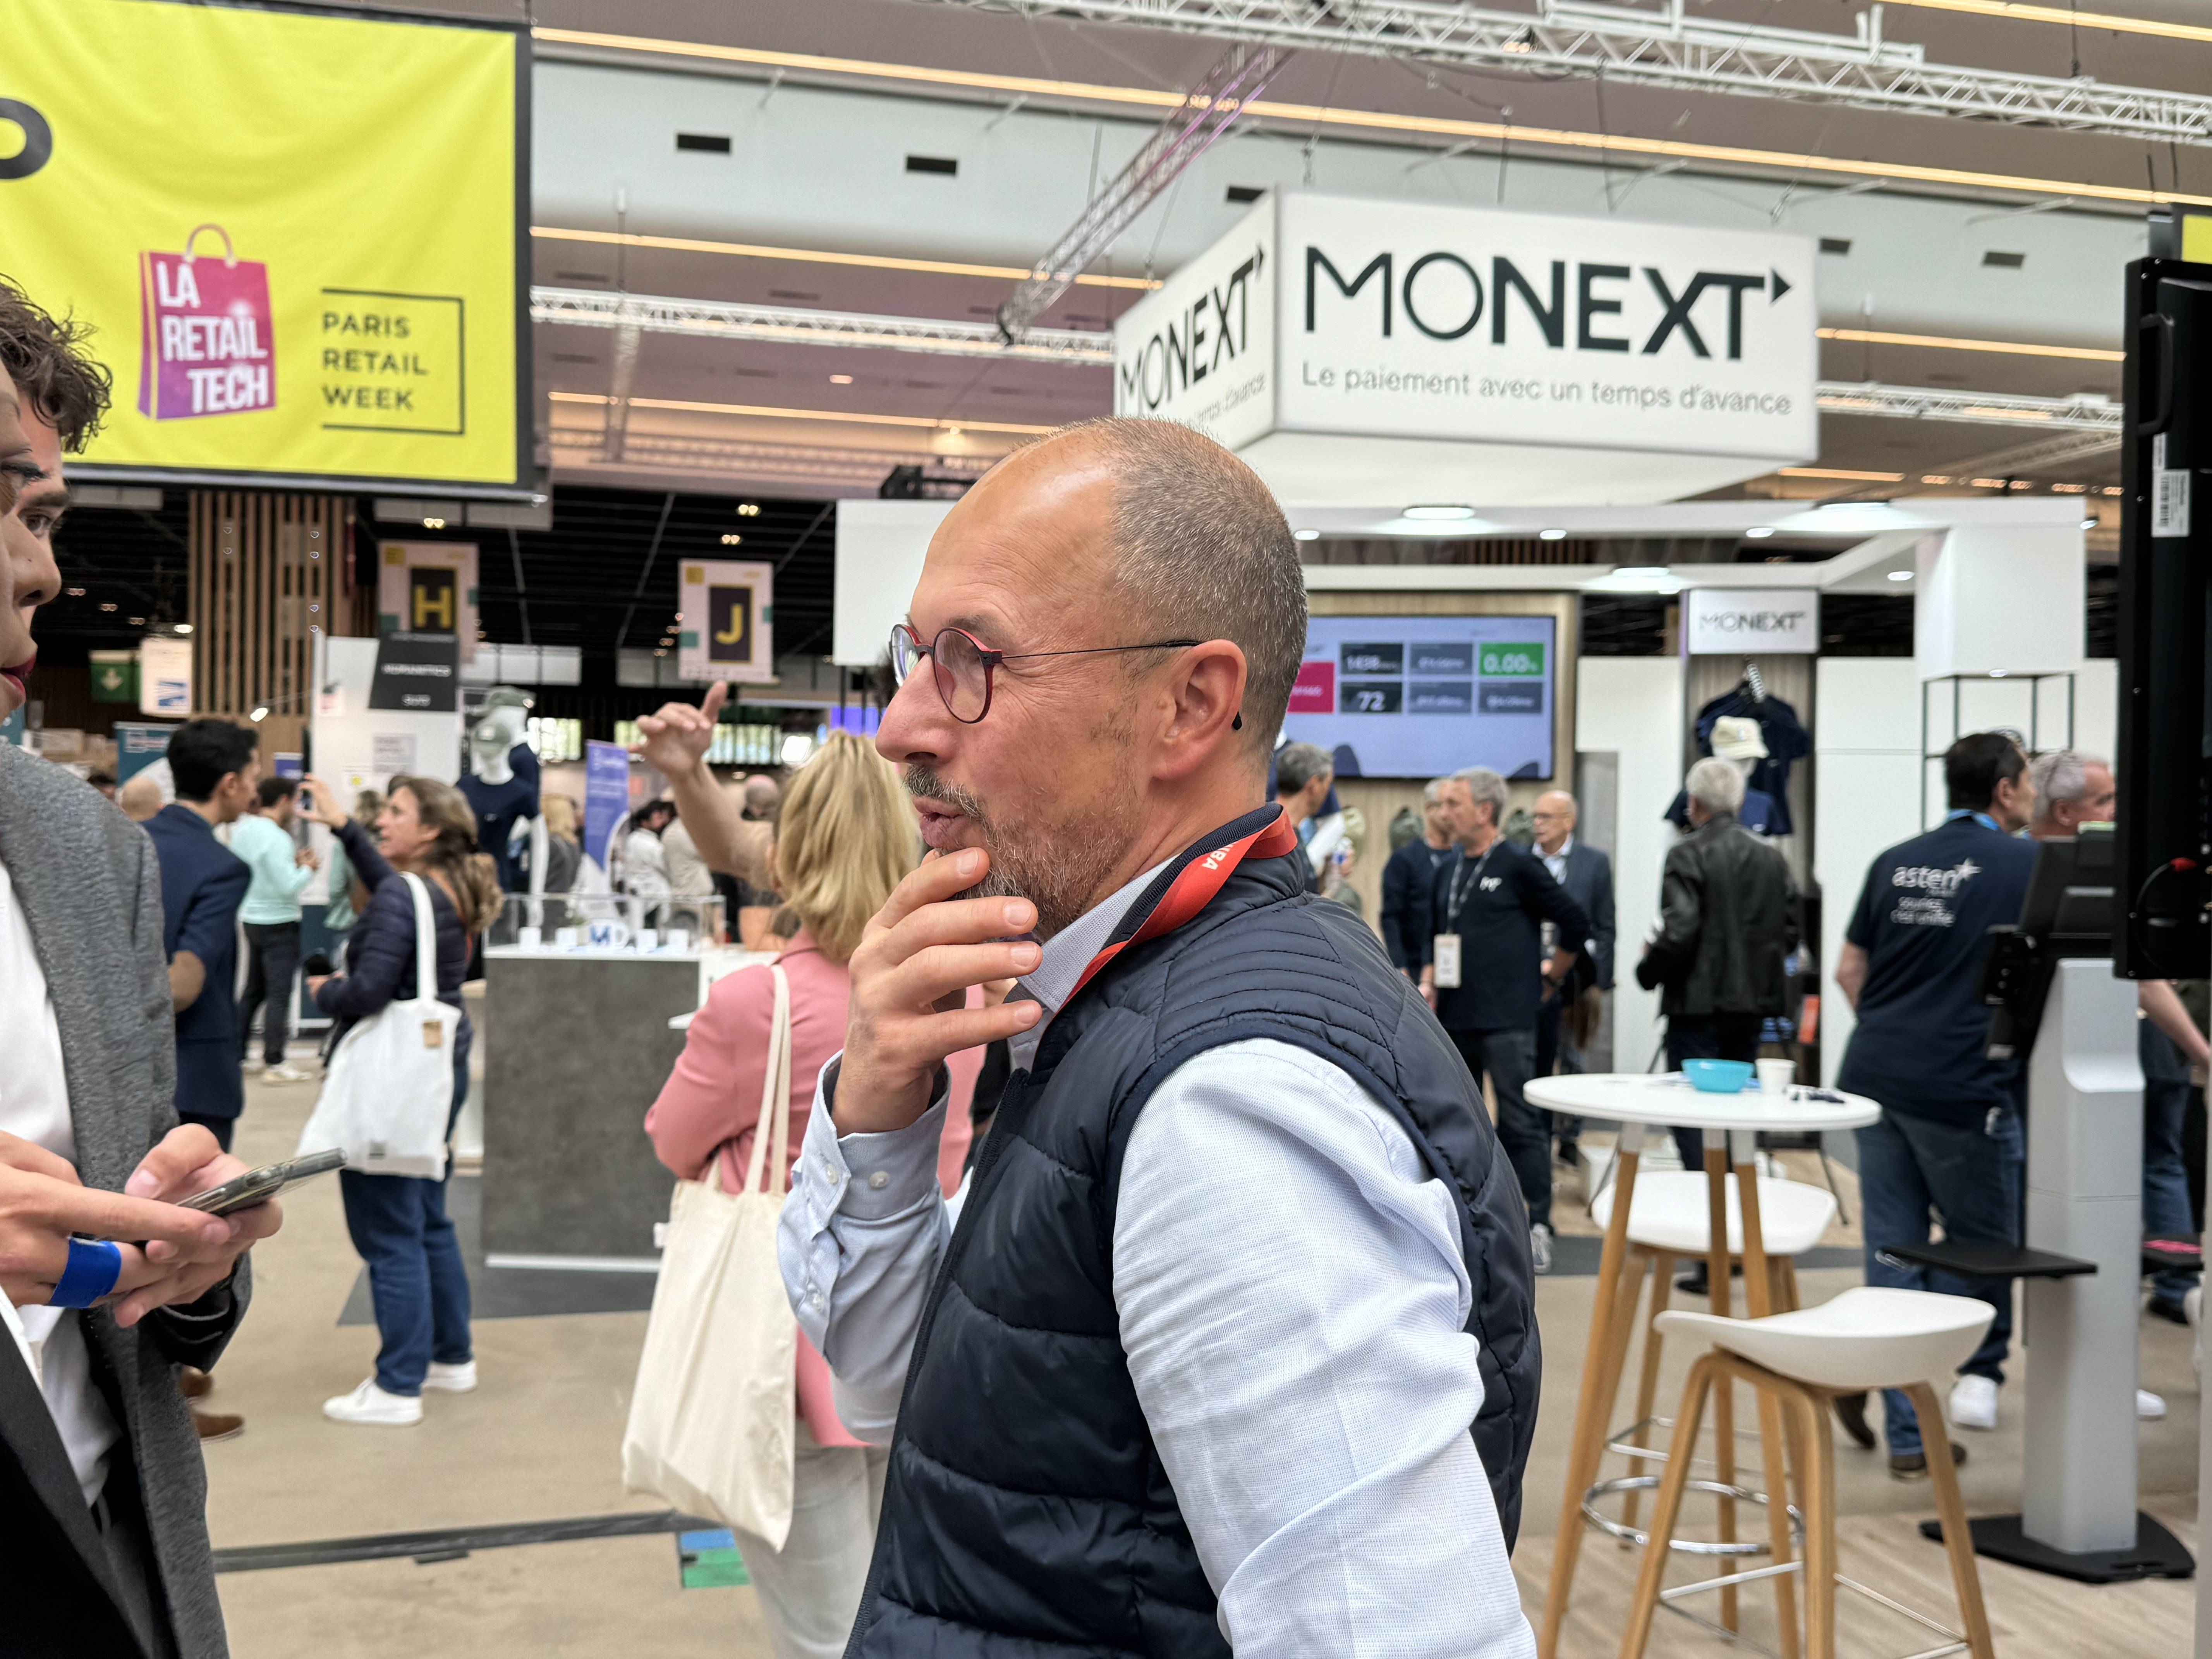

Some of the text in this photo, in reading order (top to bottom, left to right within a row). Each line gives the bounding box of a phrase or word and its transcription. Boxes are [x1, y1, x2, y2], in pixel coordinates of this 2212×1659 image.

[156, 261, 201, 308] LA
[1306, 246, 1765, 360] MONEXT
[161, 314, 268, 361] RETAIL
[322, 312, 410, 338] PARIS
[1120, 252, 1254, 417] MONEXT
[322, 348, 428, 376] RETAIL
[187, 365, 269, 414] TECH
[322, 386, 414, 412] WEEK
[1302, 361, 1793, 416] Le paiement avec un temps d'avance
[414, 585, 452, 629] H
[715, 604, 742, 645] J
[1699, 611, 1805, 632] MONEXT
[1357, 691, 1386, 711] 72
